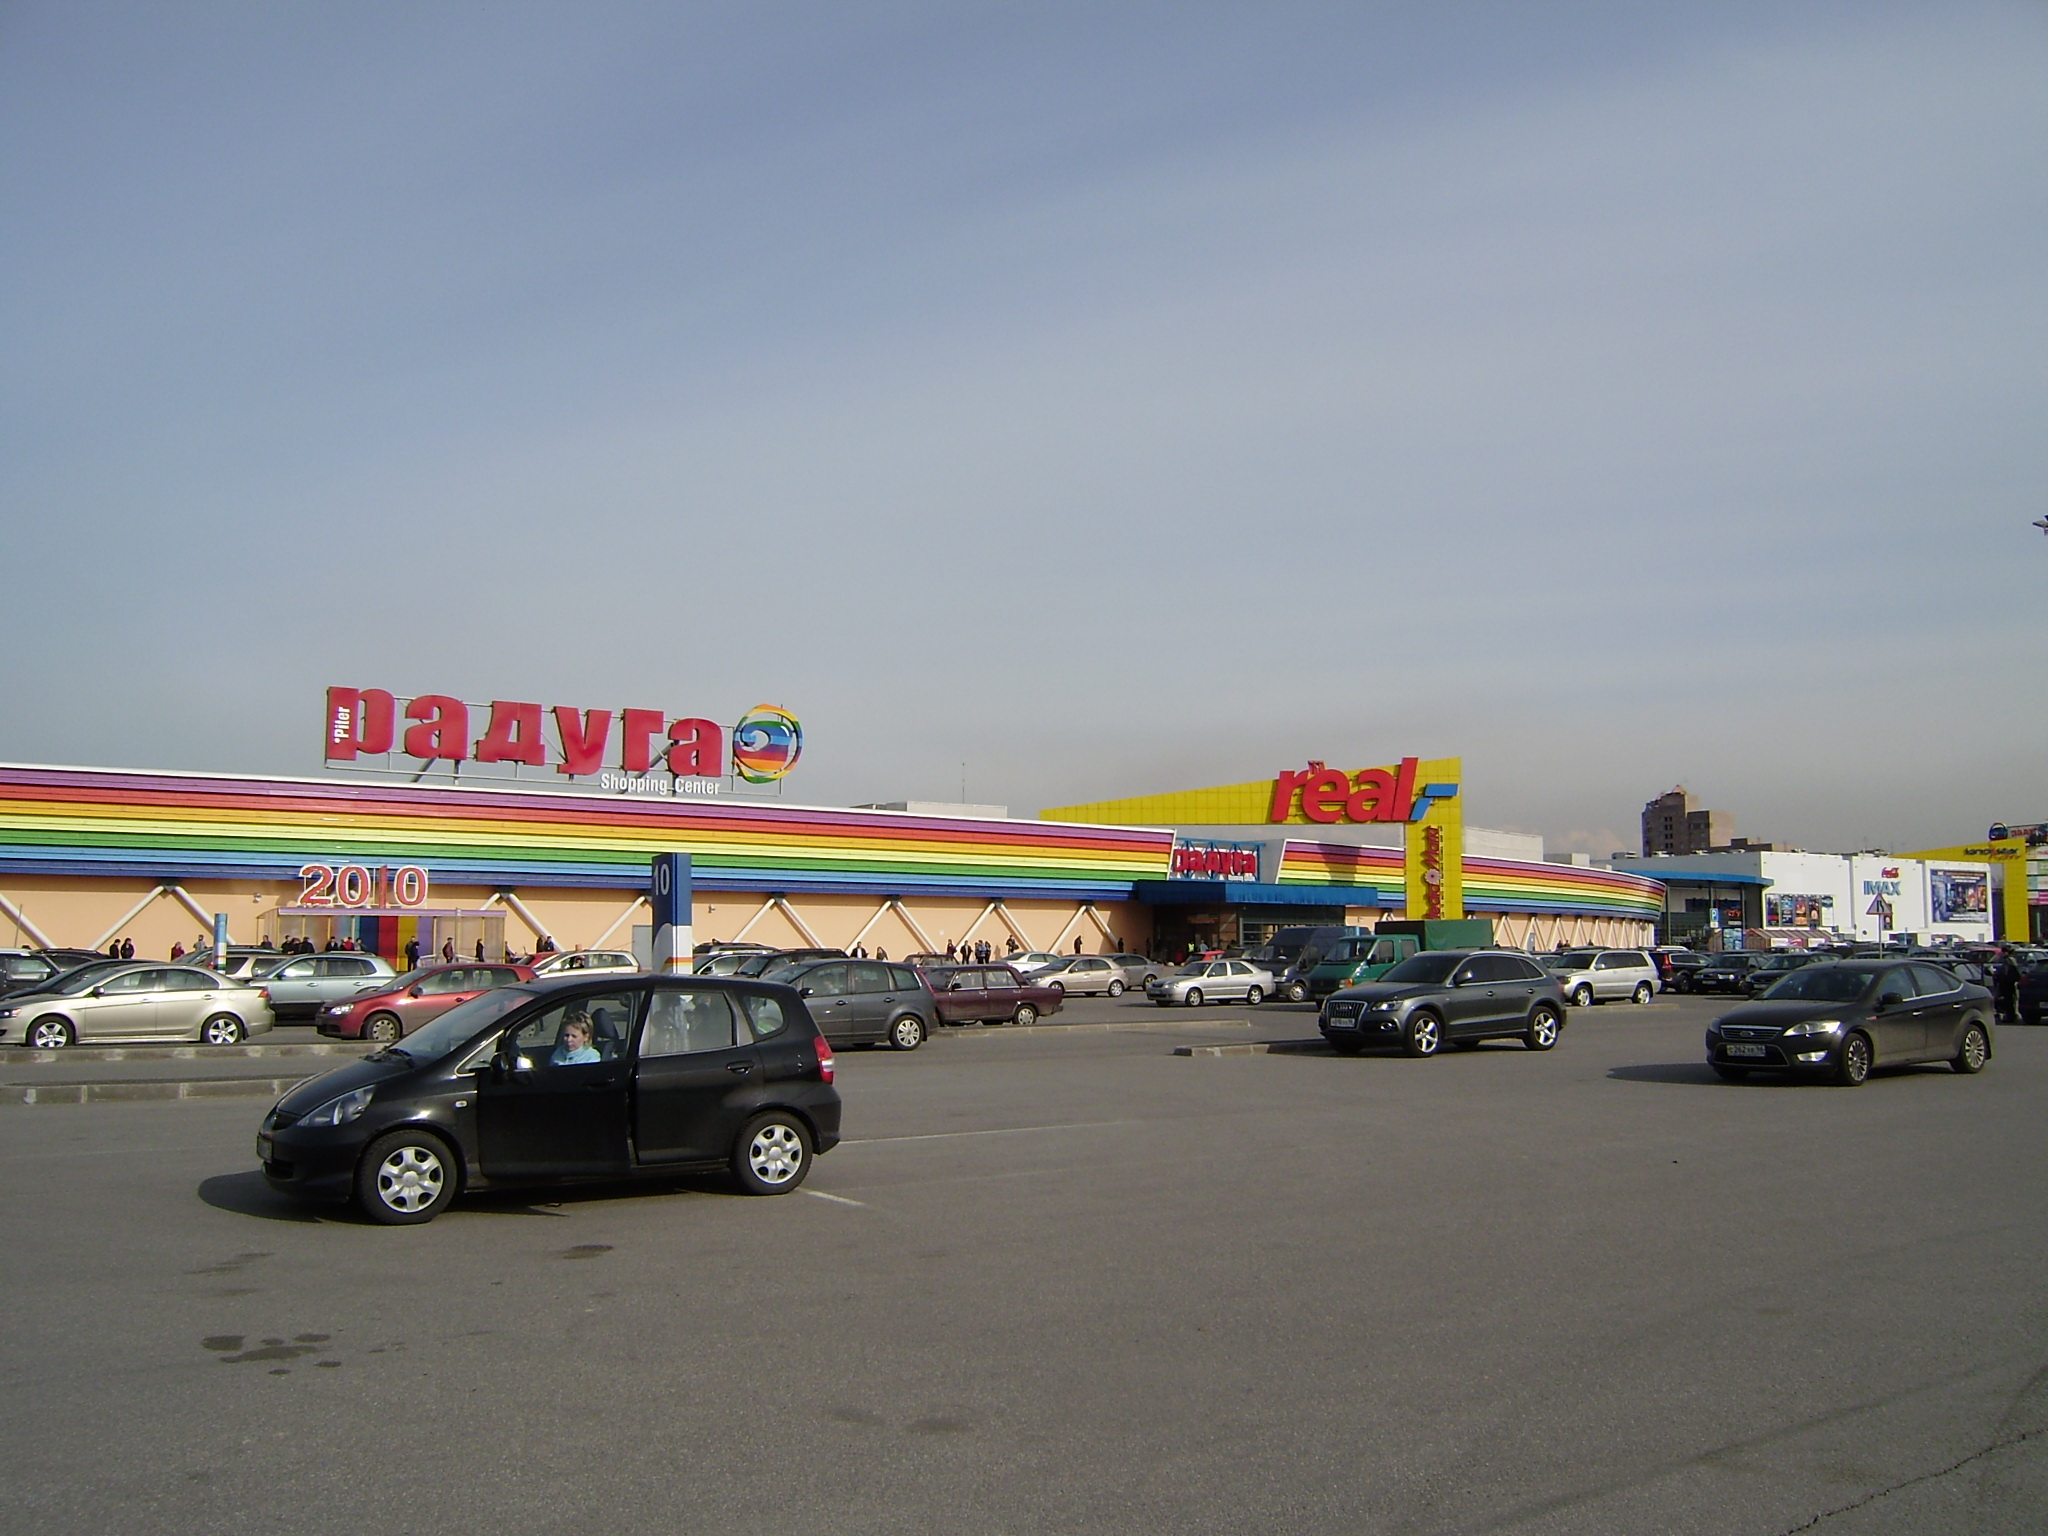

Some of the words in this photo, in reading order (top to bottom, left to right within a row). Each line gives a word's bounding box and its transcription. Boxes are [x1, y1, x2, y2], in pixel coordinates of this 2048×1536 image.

[326, 686, 723, 778] радуга
[600, 773, 668, 795] Shopping
[674, 778, 721, 795] Center
[298, 863, 429, 909] 2010
[653, 863, 670, 896] 10
[1863, 880, 1901, 896] IMAX
